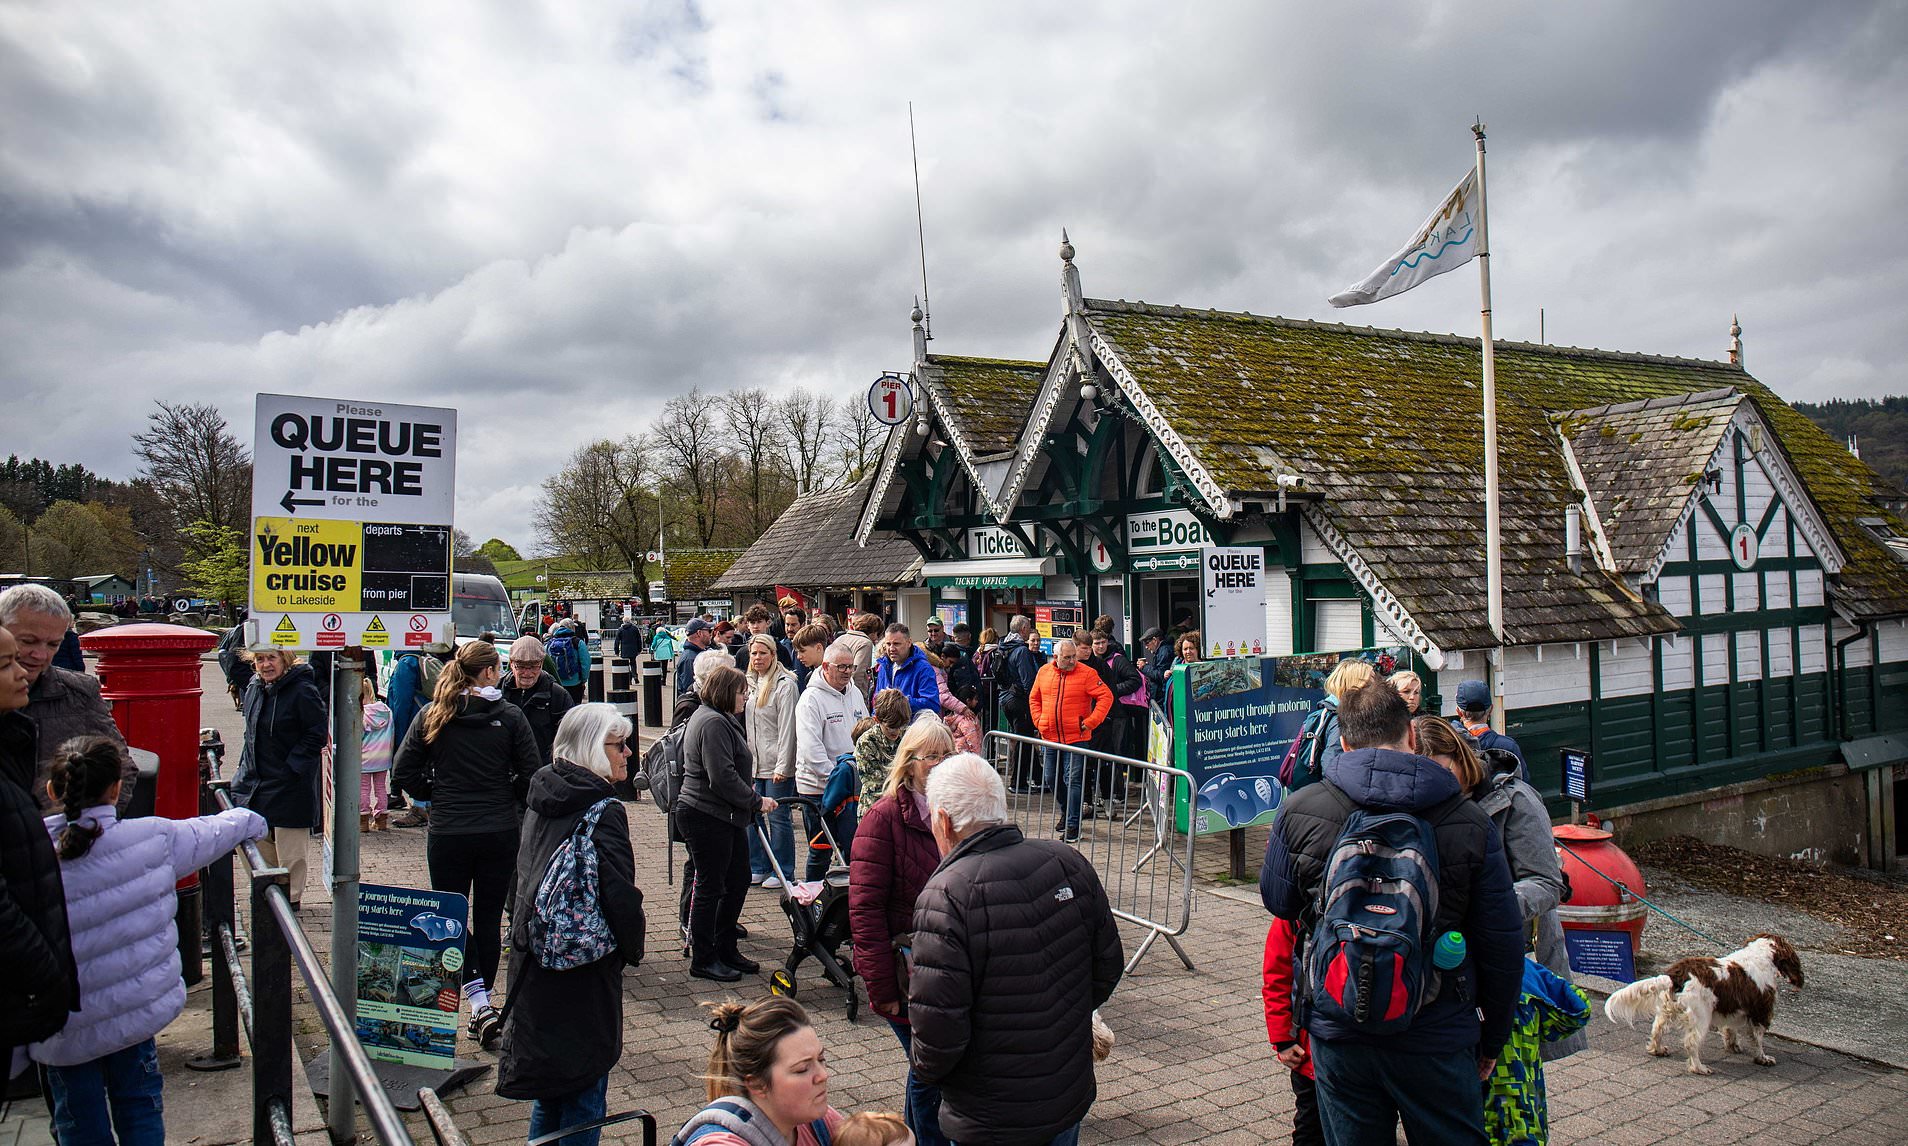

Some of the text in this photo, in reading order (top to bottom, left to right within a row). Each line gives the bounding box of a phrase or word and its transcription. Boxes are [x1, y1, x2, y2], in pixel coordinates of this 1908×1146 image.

[881, 382, 901, 390] PIER
[336, 404, 382, 417] Please
[883, 391, 896, 418] 1
[271, 413, 442, 457] QUEUE
[290, 455, 423, 496] HERE
[332, 496, 378, 507] for the
[297, 523, 319, 534] next
[366, 525, 402, 536] departs
[1130, 520, 1156, 532] To the
[257, 534, 356, 567] Yellow
[975, 531, 1023, 554] Ticket
[1740, 537, 1747, 560] 1
[1097, 543, 1104, 562] 1
[1209, 555, 1260, 571] QUEUE
[266, 570, 346, 592] cruise
[955, 576, 1008, 585] TICKET OFFICE
[1215, 572, 1256, 588] HERE
[277, 595, 335, 606] to Lakeside
[363, 588, 407, 600] from pier
[1194, 698, 1311, 723] Your journey through motoring
[1194, 722, 1268, 743] history starts here
[365, 891, 387, 904] journey
[389, 894, 411, 906] through
[413, 898, 440, 910] motoring
[370, 905, 388, 914] starts
[389, 906, 404, 916] here
